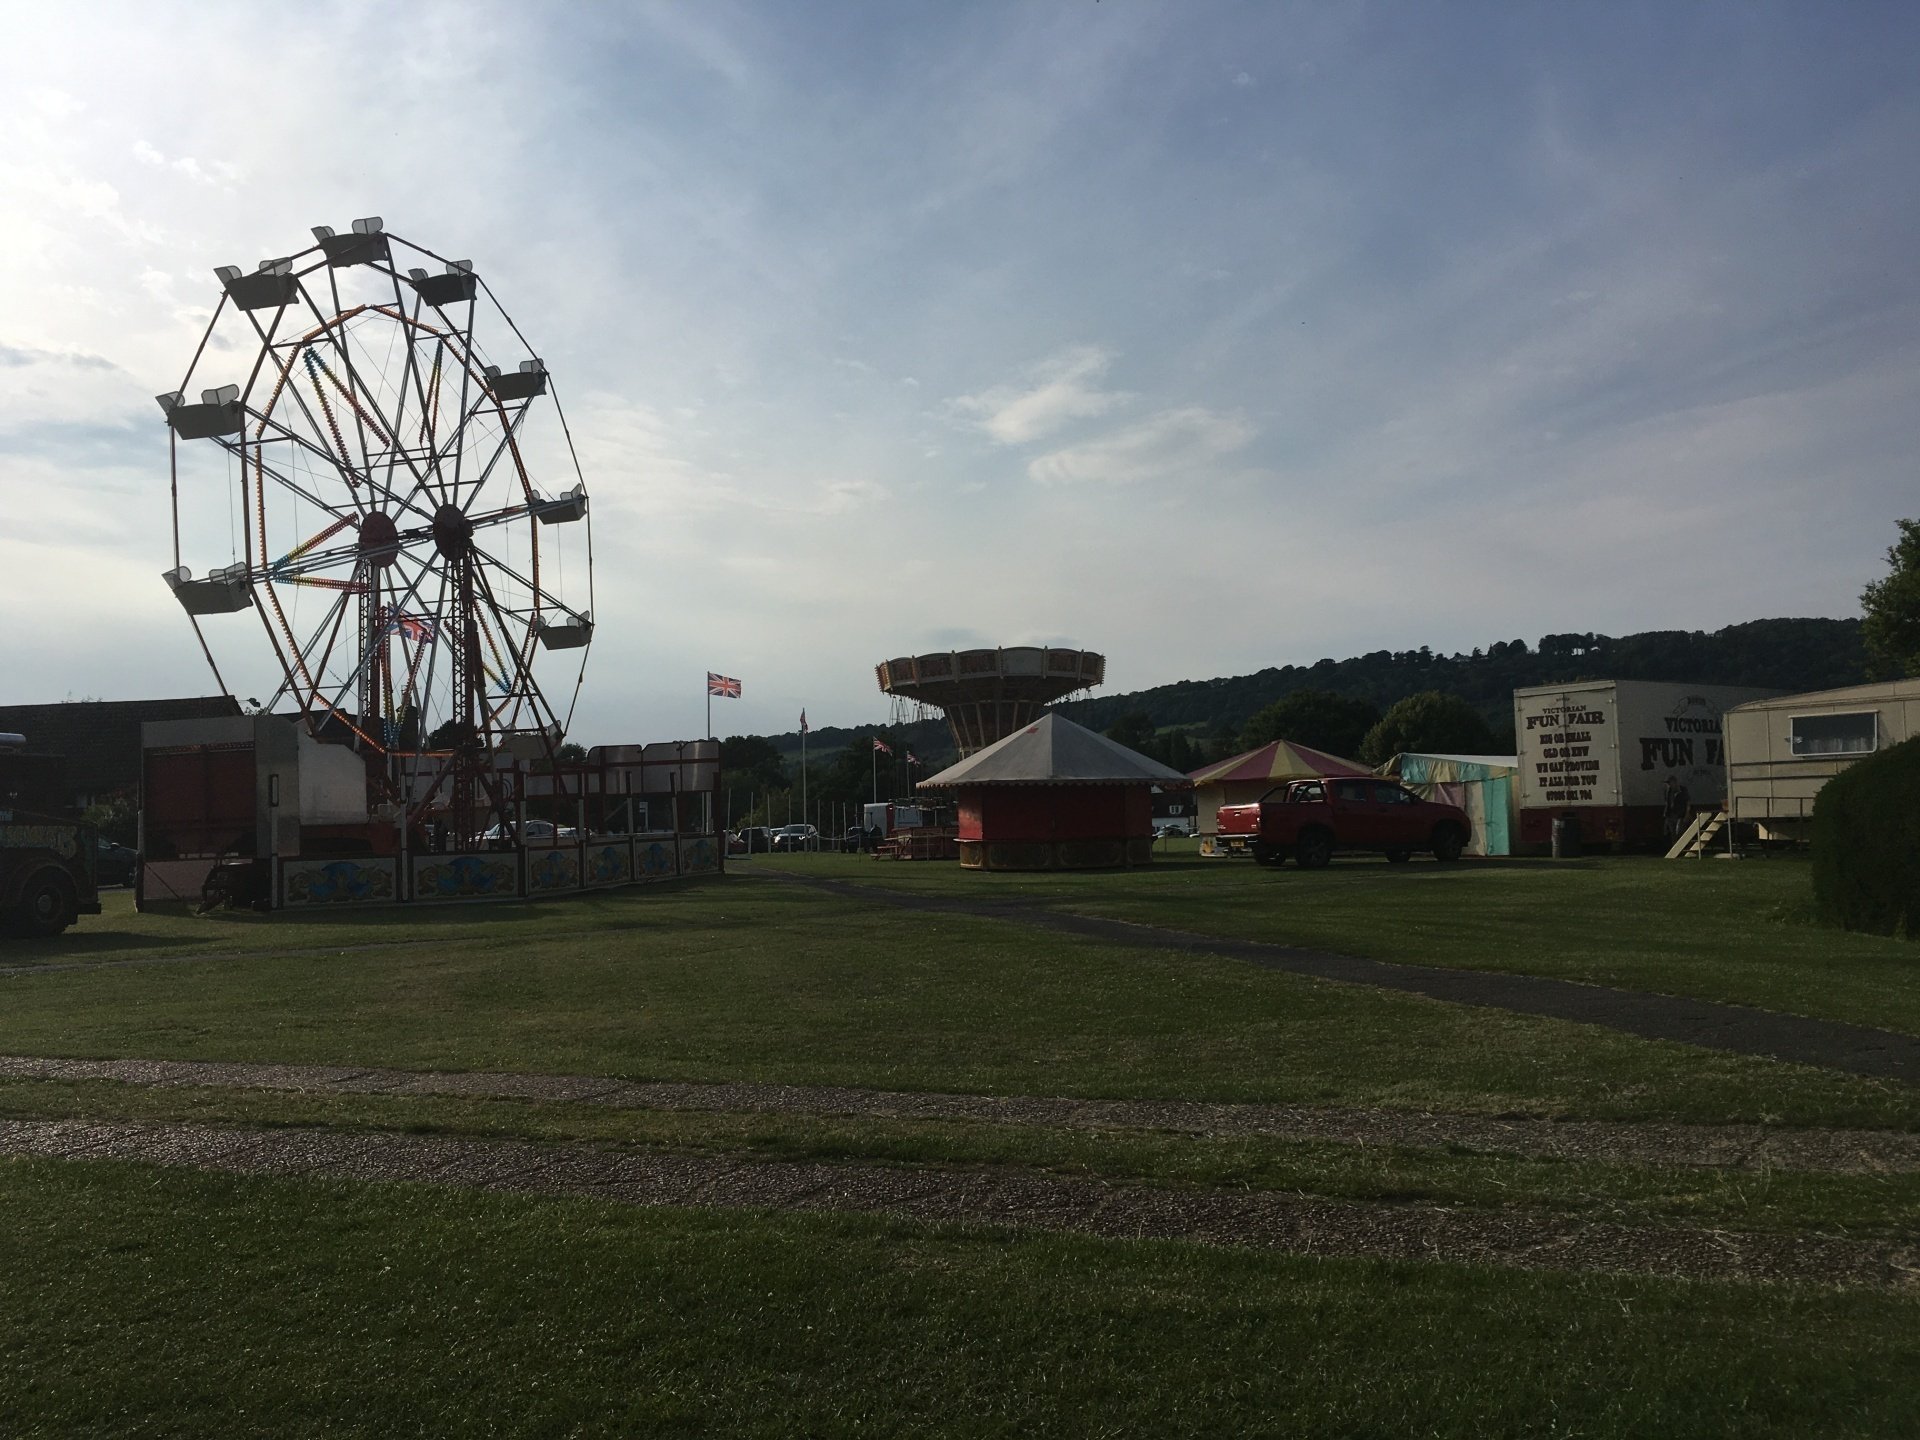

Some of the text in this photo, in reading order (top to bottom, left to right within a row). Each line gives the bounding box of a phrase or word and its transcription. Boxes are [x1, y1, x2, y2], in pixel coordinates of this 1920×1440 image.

[1543, 705, 1587, 714] VICTORIAN
[1526, 711, 1605, 730] FUN FAIR
[1664, 717, 1723, 733] VICTORIA
[1639, 737, 1725, 770] FUN FA
[1549, 776, 1563, 787] ALL
[1581, 775, 1597, 786] YOU
